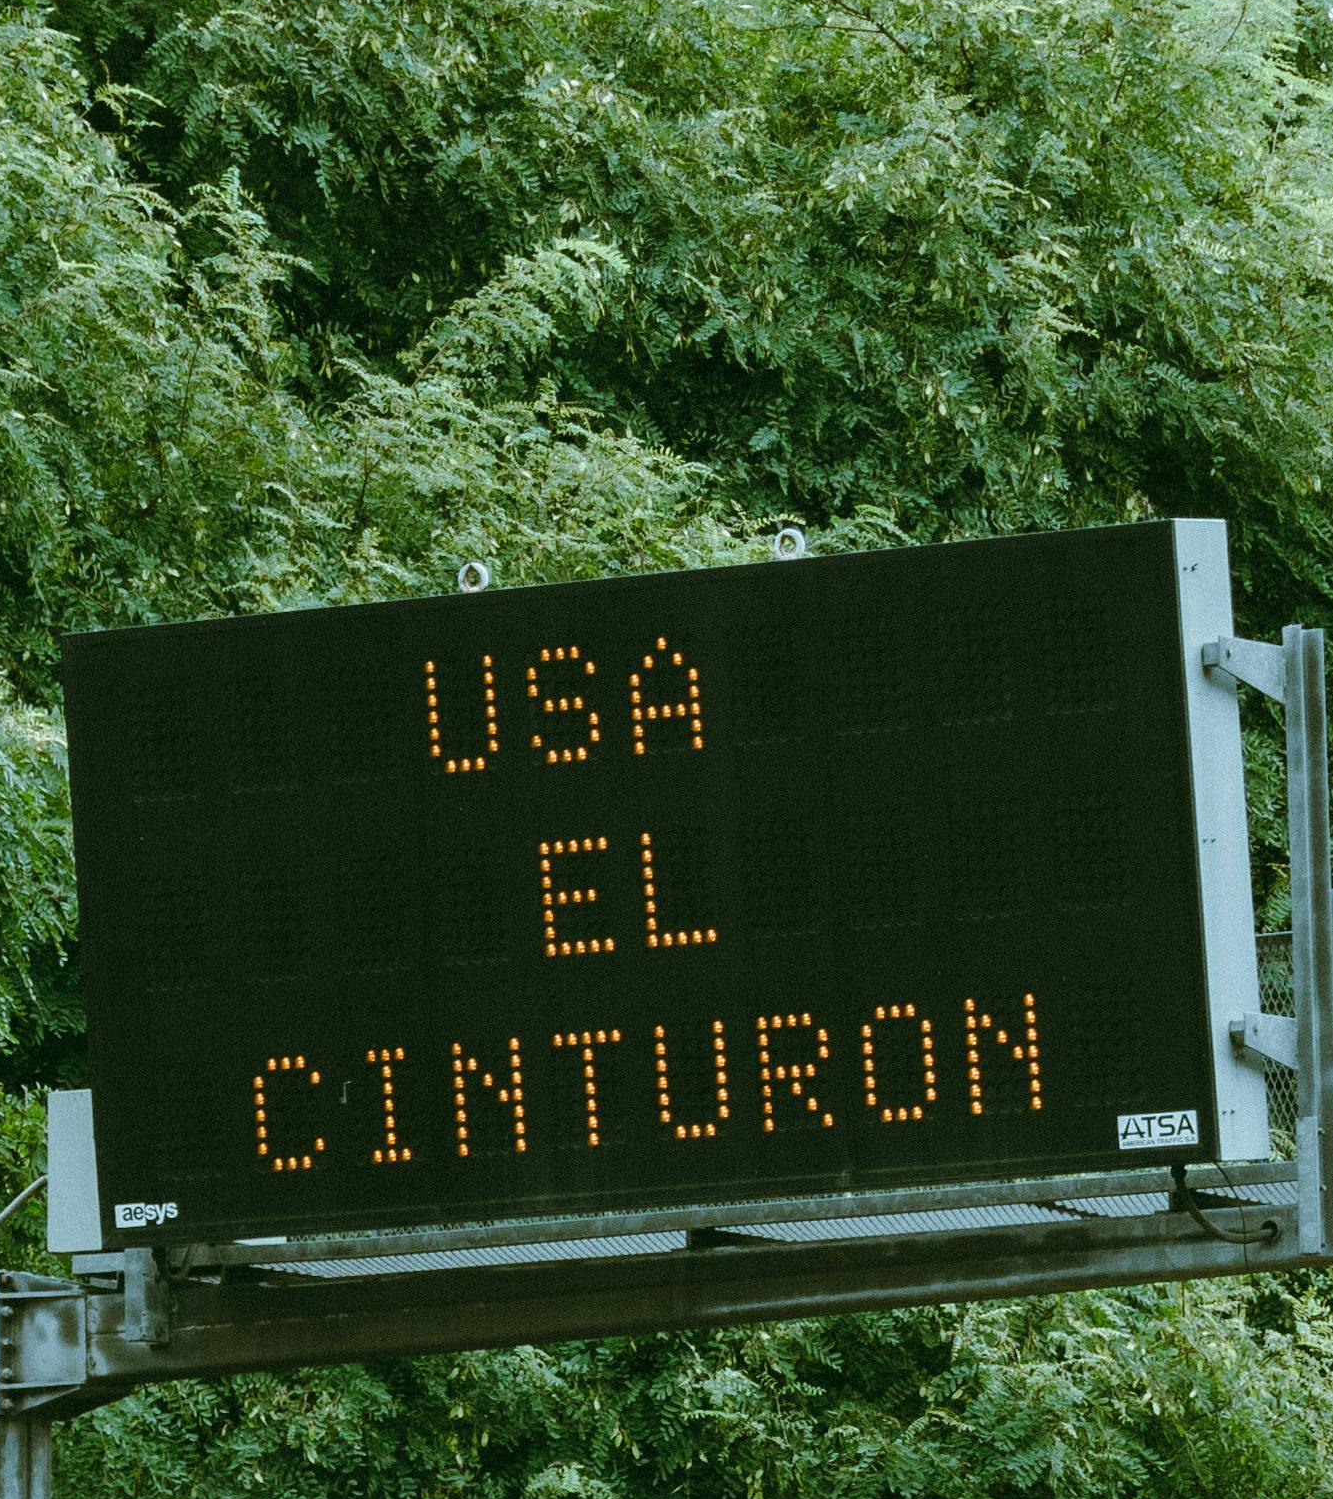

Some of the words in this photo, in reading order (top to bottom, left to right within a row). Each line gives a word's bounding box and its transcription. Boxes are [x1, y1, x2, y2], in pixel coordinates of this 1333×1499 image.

[424, 636, 705, 773] USA
[539, 832, 719, 957] EL
[253, 992, 1043, 1173] CINTURON
[1120, 1113, 1195, 1139] ATSA
[122, 1202, 178, 1225] aesys
